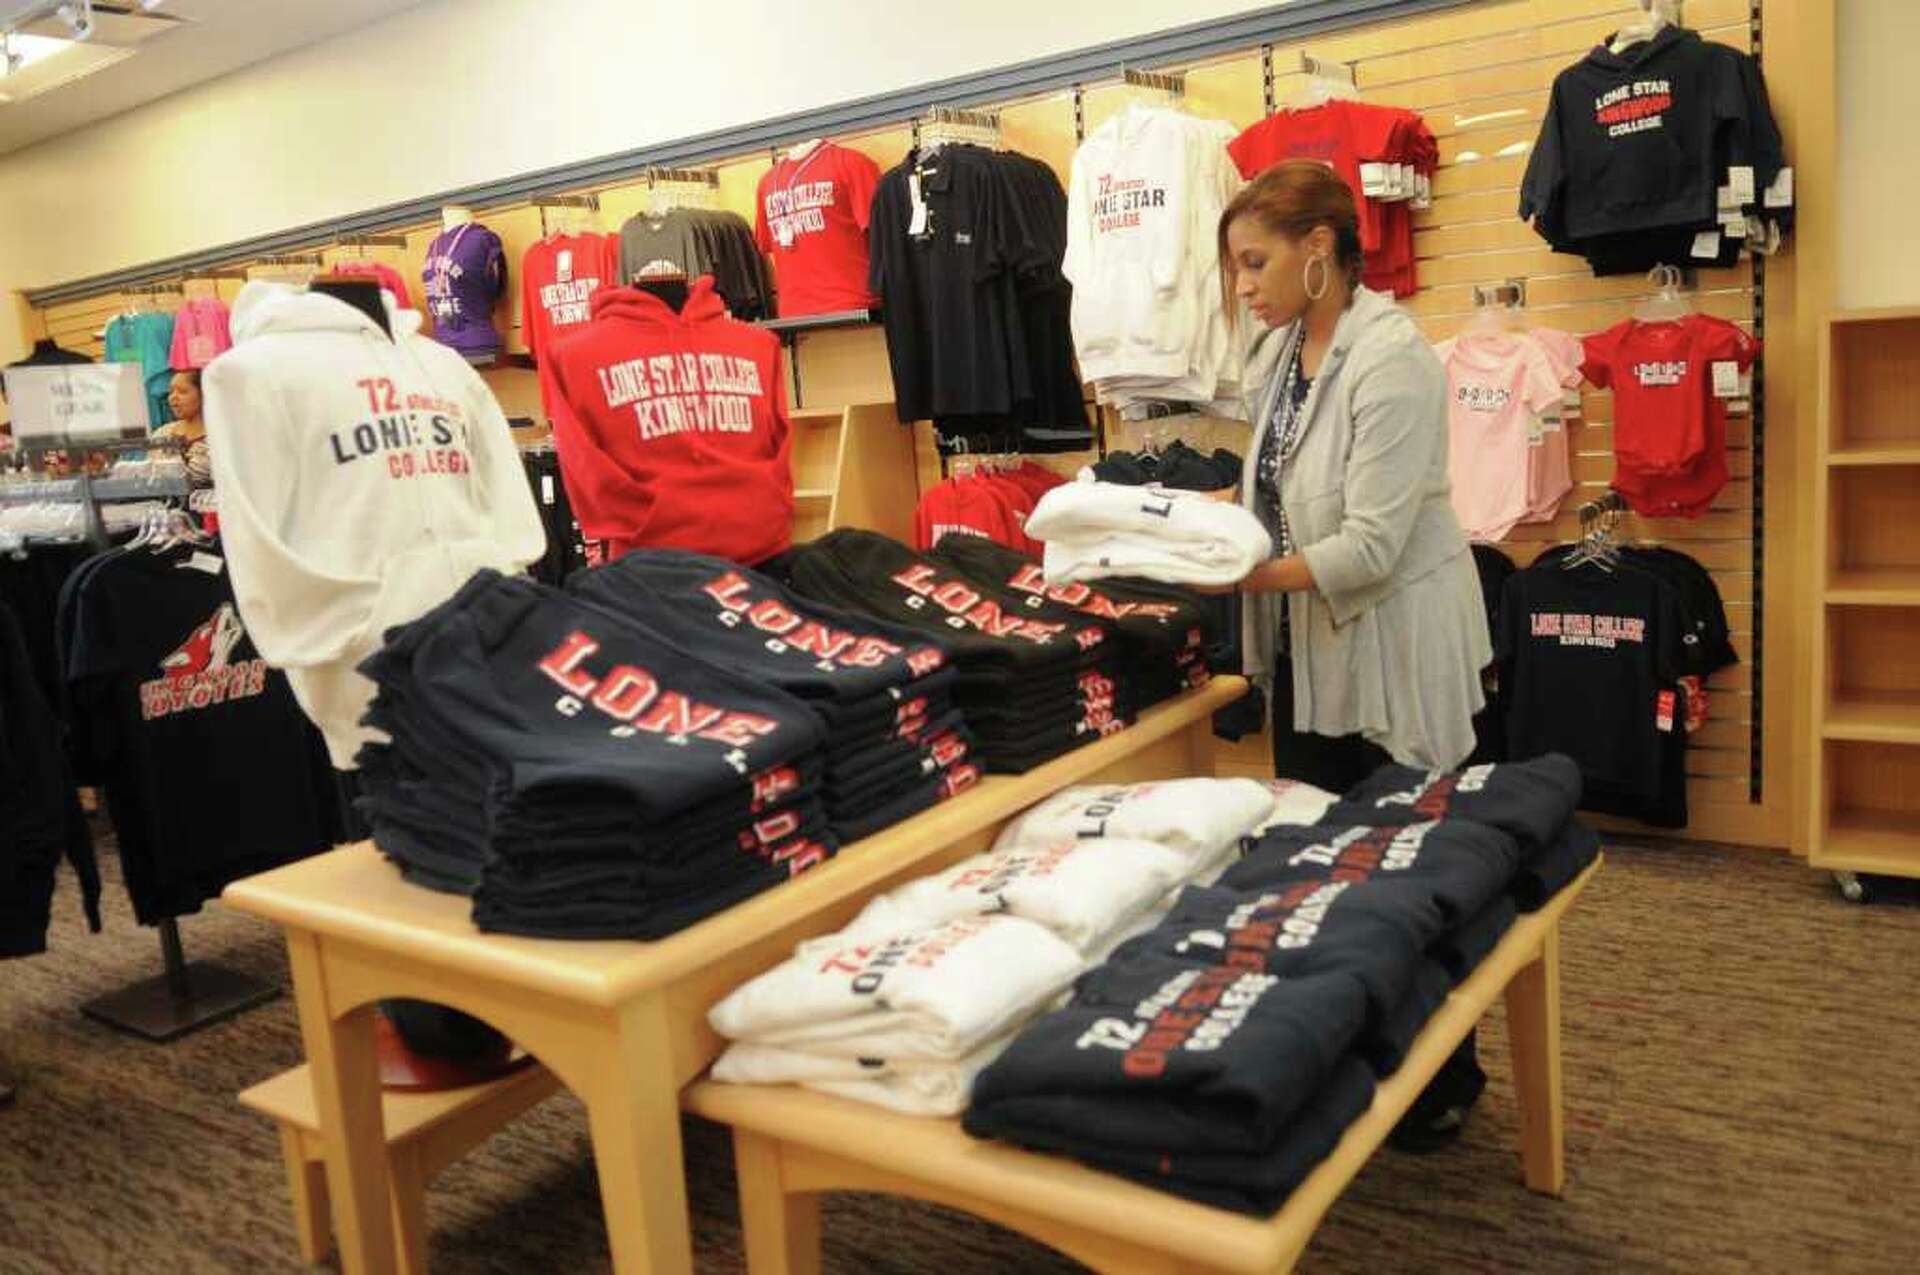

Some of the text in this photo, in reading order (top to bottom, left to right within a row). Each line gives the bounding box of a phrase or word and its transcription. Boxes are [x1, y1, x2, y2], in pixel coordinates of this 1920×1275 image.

[1595, 80, 1671, 110] LONE STAR
[1123, 188, 1166, 210] STAR
[356, 377, 401, 415] 72
[598, 358, 652, 409] LONE
[650, 352, 701, 395] STAR
[634, 394, 753, 440] KINGWOOD
[703, 570, 904, 668] LONE
[537, 628, 779, 747] LONE
[1074, 1016, 1149, 1051] 72
